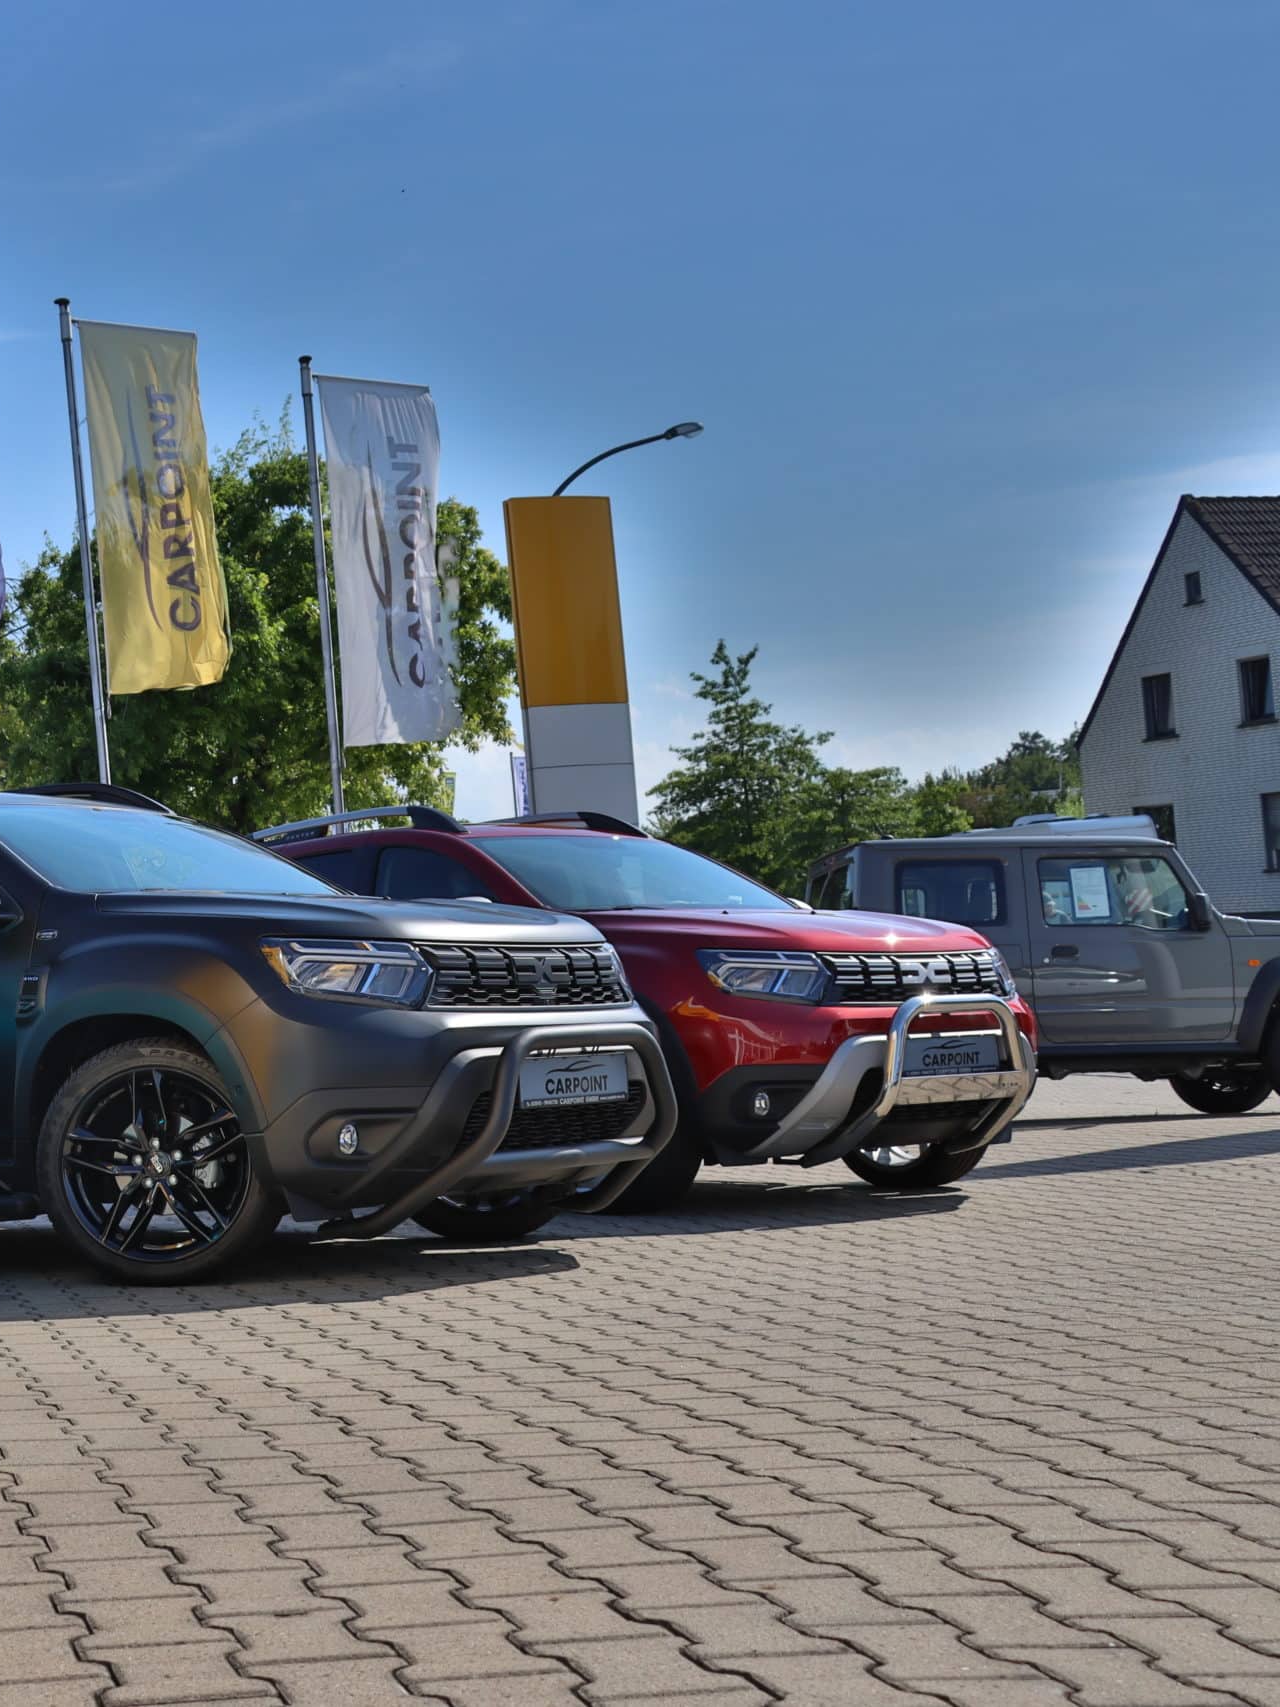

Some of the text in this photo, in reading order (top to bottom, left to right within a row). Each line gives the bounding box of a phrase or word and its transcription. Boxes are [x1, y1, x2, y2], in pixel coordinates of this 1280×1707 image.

[145, 383, 202, 632] CARPOINT
[922, 1051, 980, 1067] CARPOINT
[545, 1074, 609, 1095] CARPOINT
